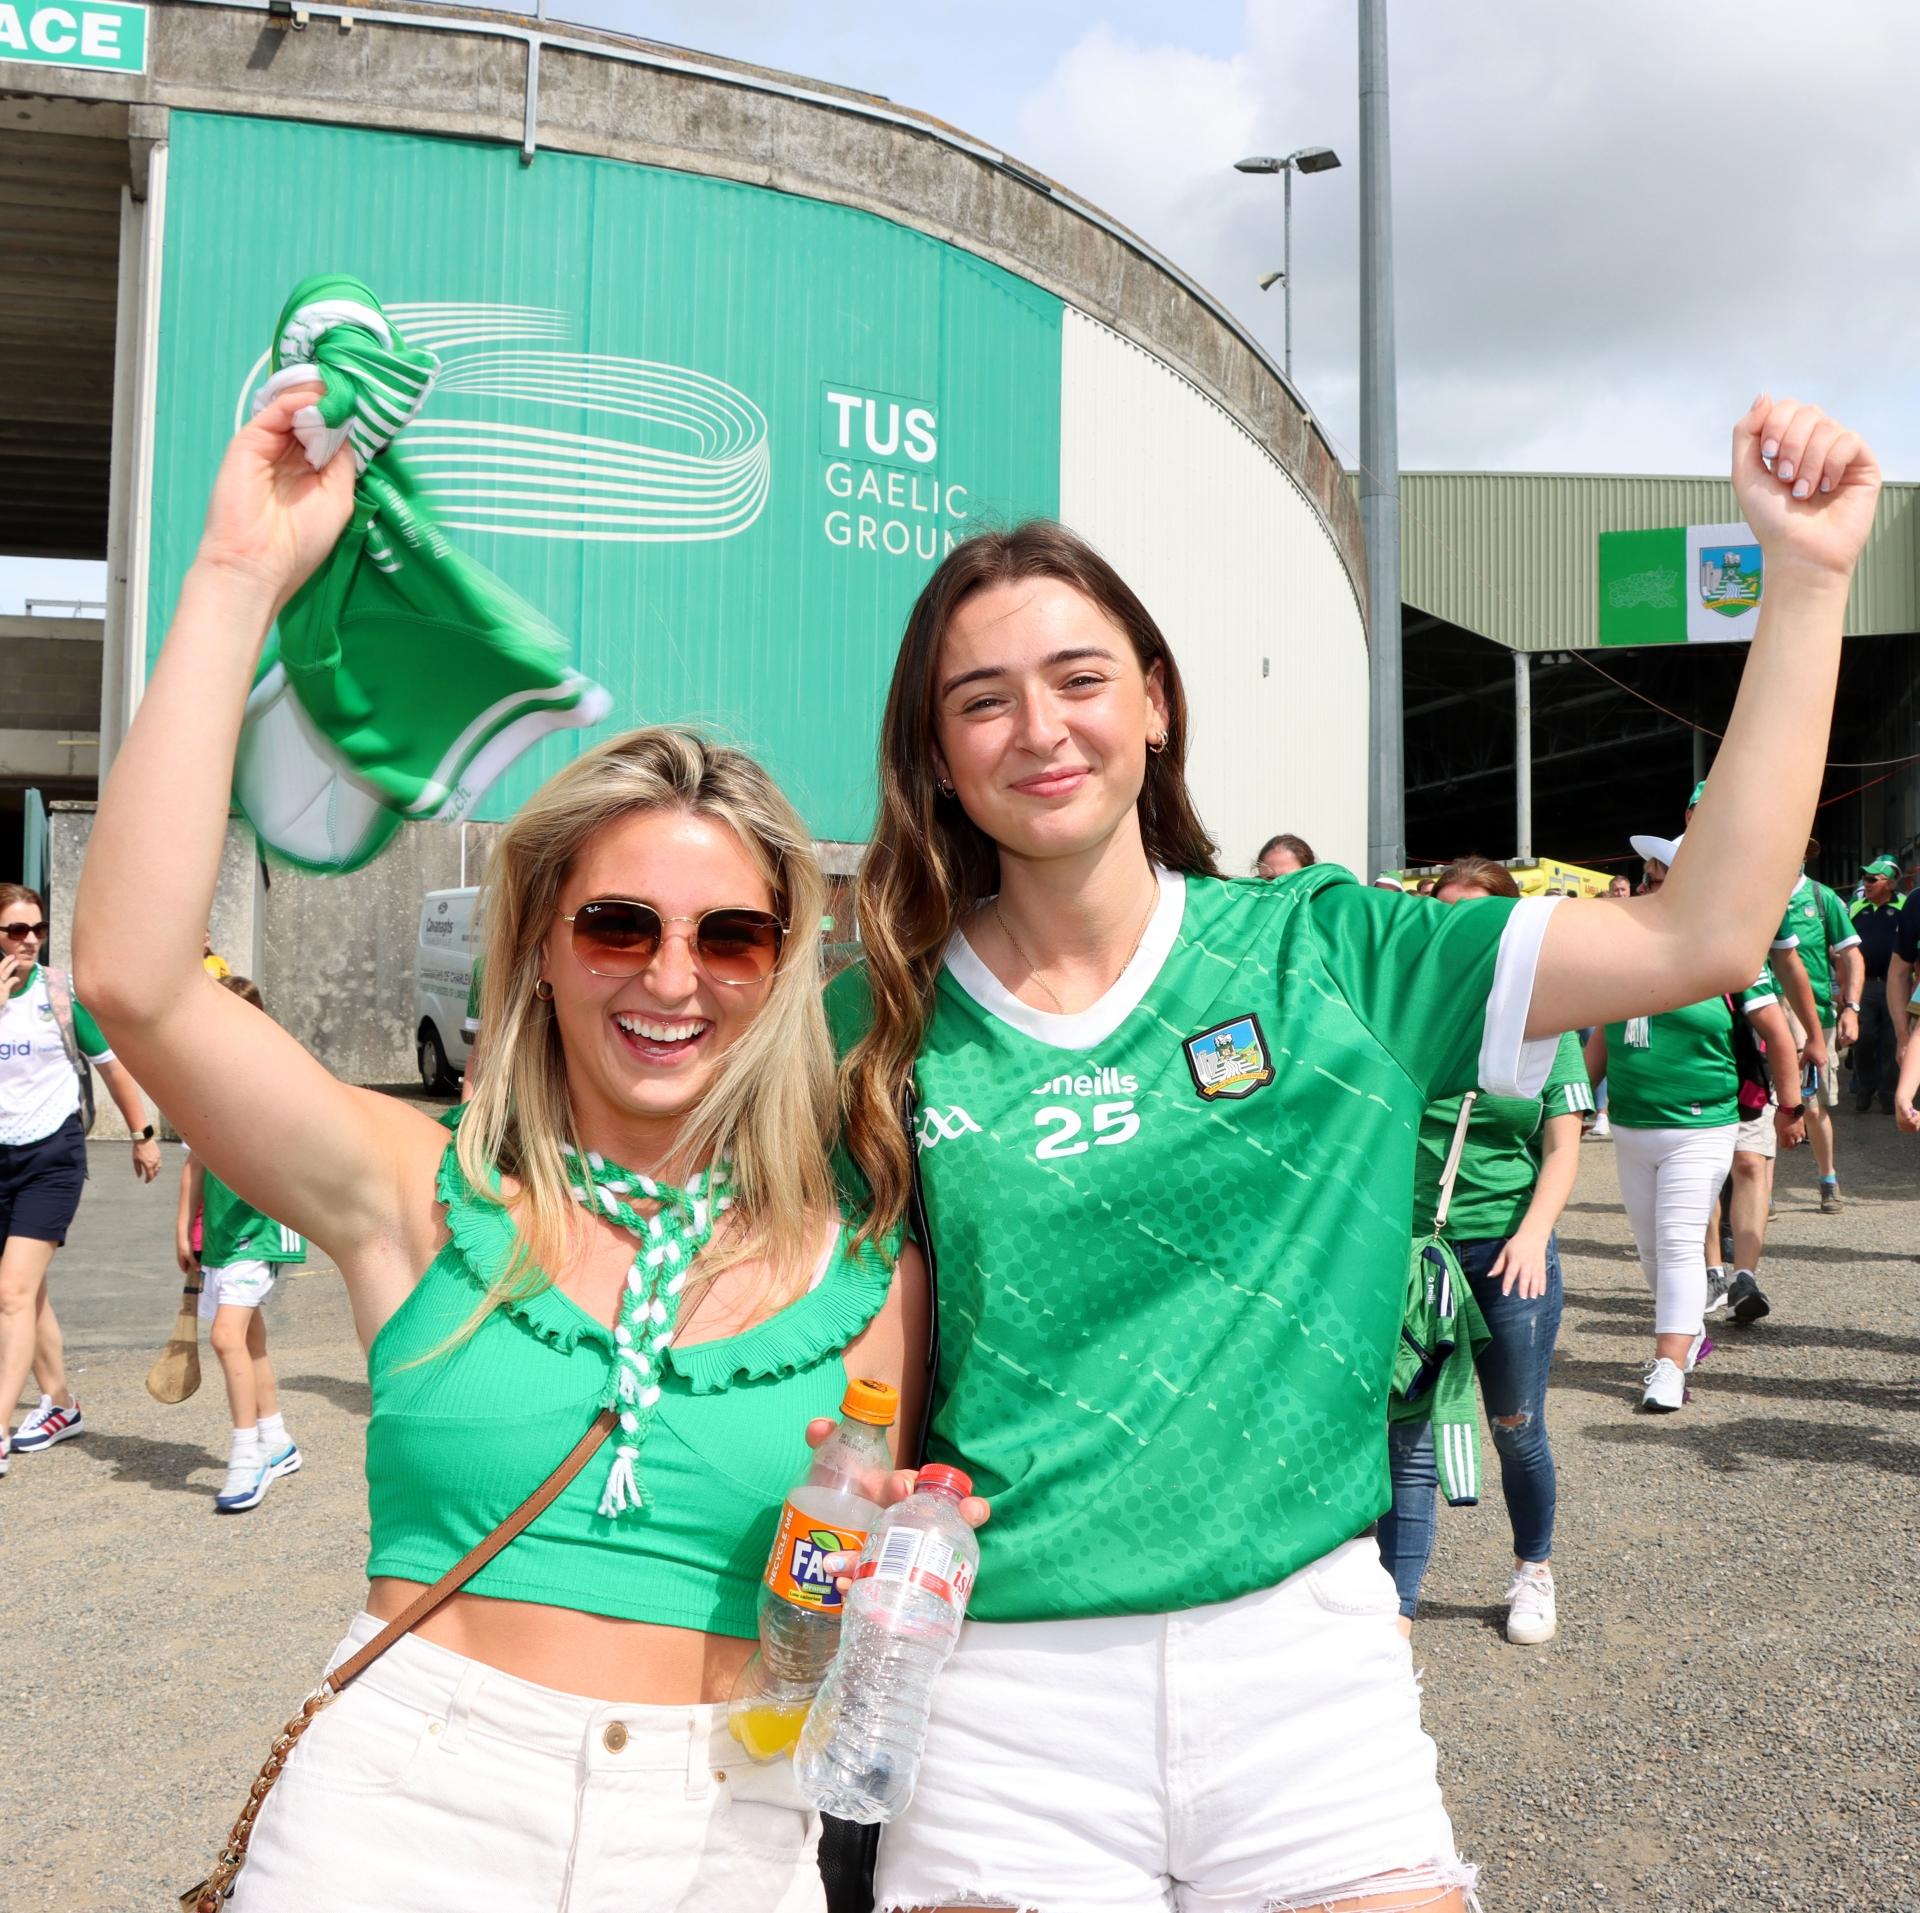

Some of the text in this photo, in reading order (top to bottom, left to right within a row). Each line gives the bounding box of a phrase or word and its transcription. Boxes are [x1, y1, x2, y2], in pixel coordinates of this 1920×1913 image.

[0, 3, 122, 59] ACE
[827, 392, 937, 463] TUS
[825, 462, 968, 519] GAELIC
[0, 1040, 30, 1060] gid
[1034, 1101, 1141, 1160] 25
[768, 1510, 794, 1586] RECYCLE ME
[791, 1539, 834, 1584] FA
